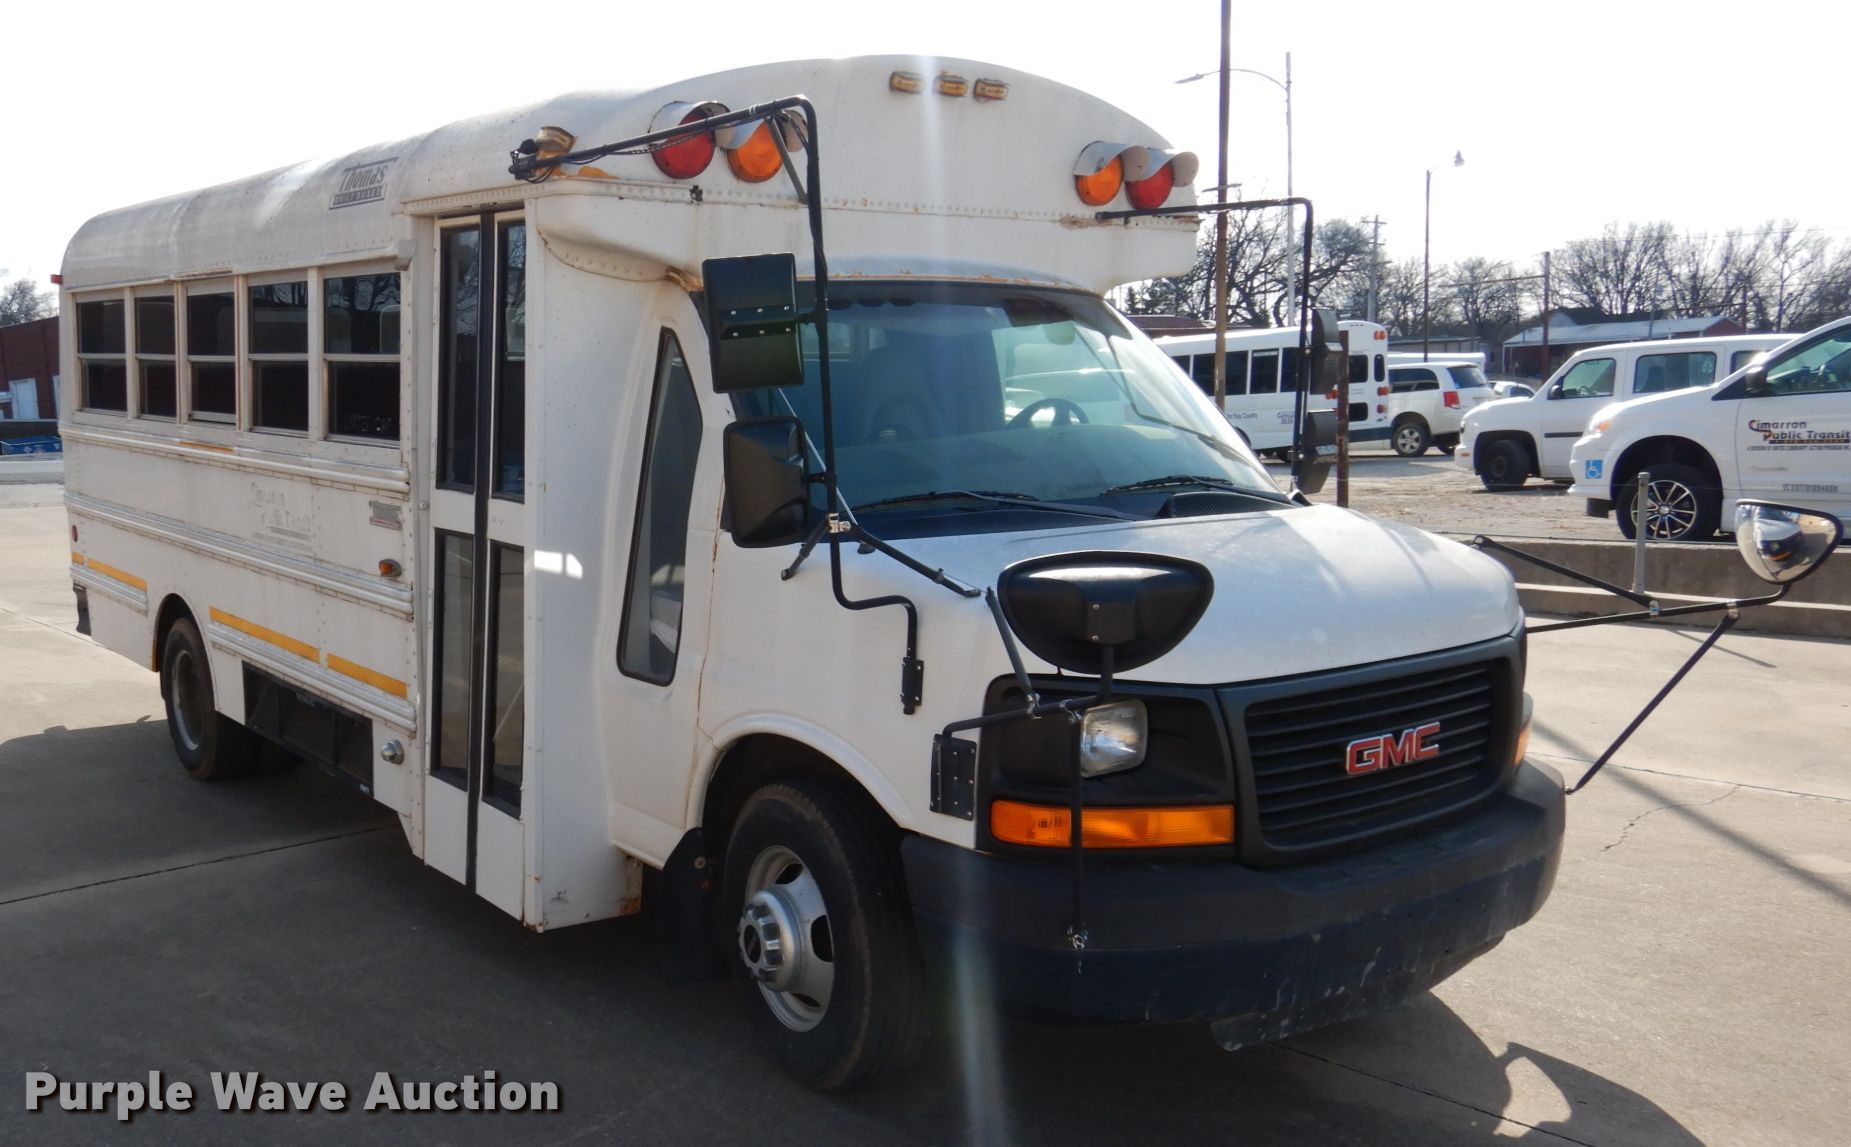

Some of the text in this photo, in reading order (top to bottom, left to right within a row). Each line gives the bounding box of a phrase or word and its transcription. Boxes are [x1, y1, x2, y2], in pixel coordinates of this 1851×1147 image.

[339, 157, 397, 192] Thomas
[1748, 419, 1807, 432] Cimarron
[1763, 430, 1850, 441] Public Transit
[1346, 721, 1440, 775] GMC
